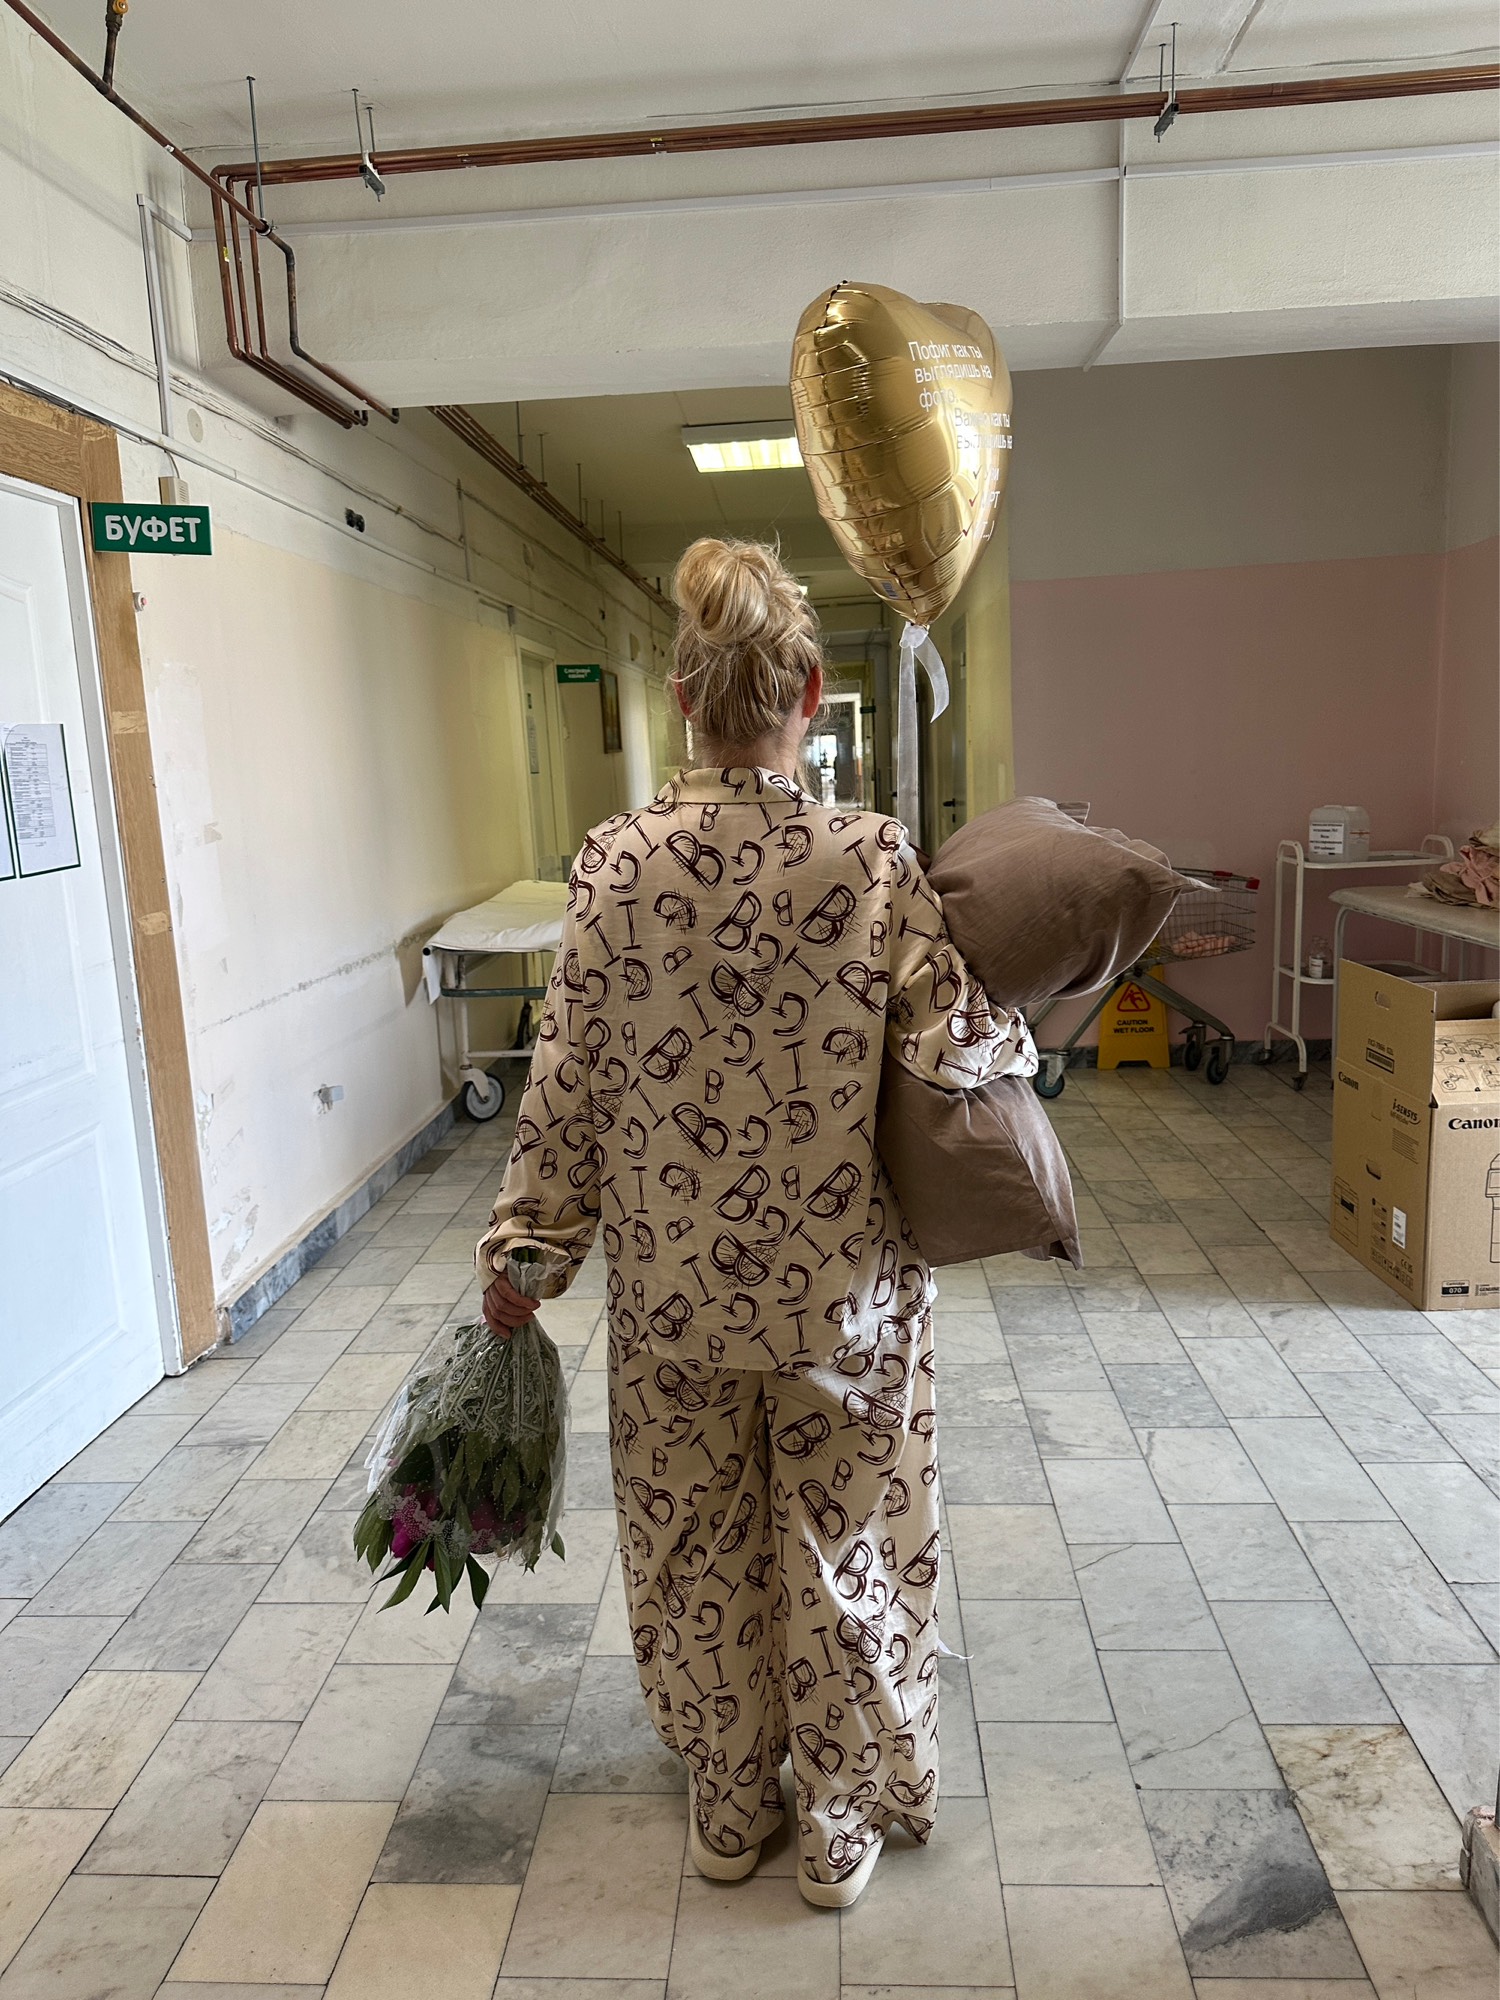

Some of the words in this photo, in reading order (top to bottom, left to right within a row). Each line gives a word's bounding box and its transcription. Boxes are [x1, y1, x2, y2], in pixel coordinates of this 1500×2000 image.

[908, 340, 951, 363] Пофиг
[951, 344, 970, 358] как
[967, 346, 983, 359] ты
[915, 364, 981, 384] выглядишь
[980, 365, 993, 379] на
[105, 515, 201, 545] БУФЕТ
[1338, 1071, 1359, 1091] Canon
